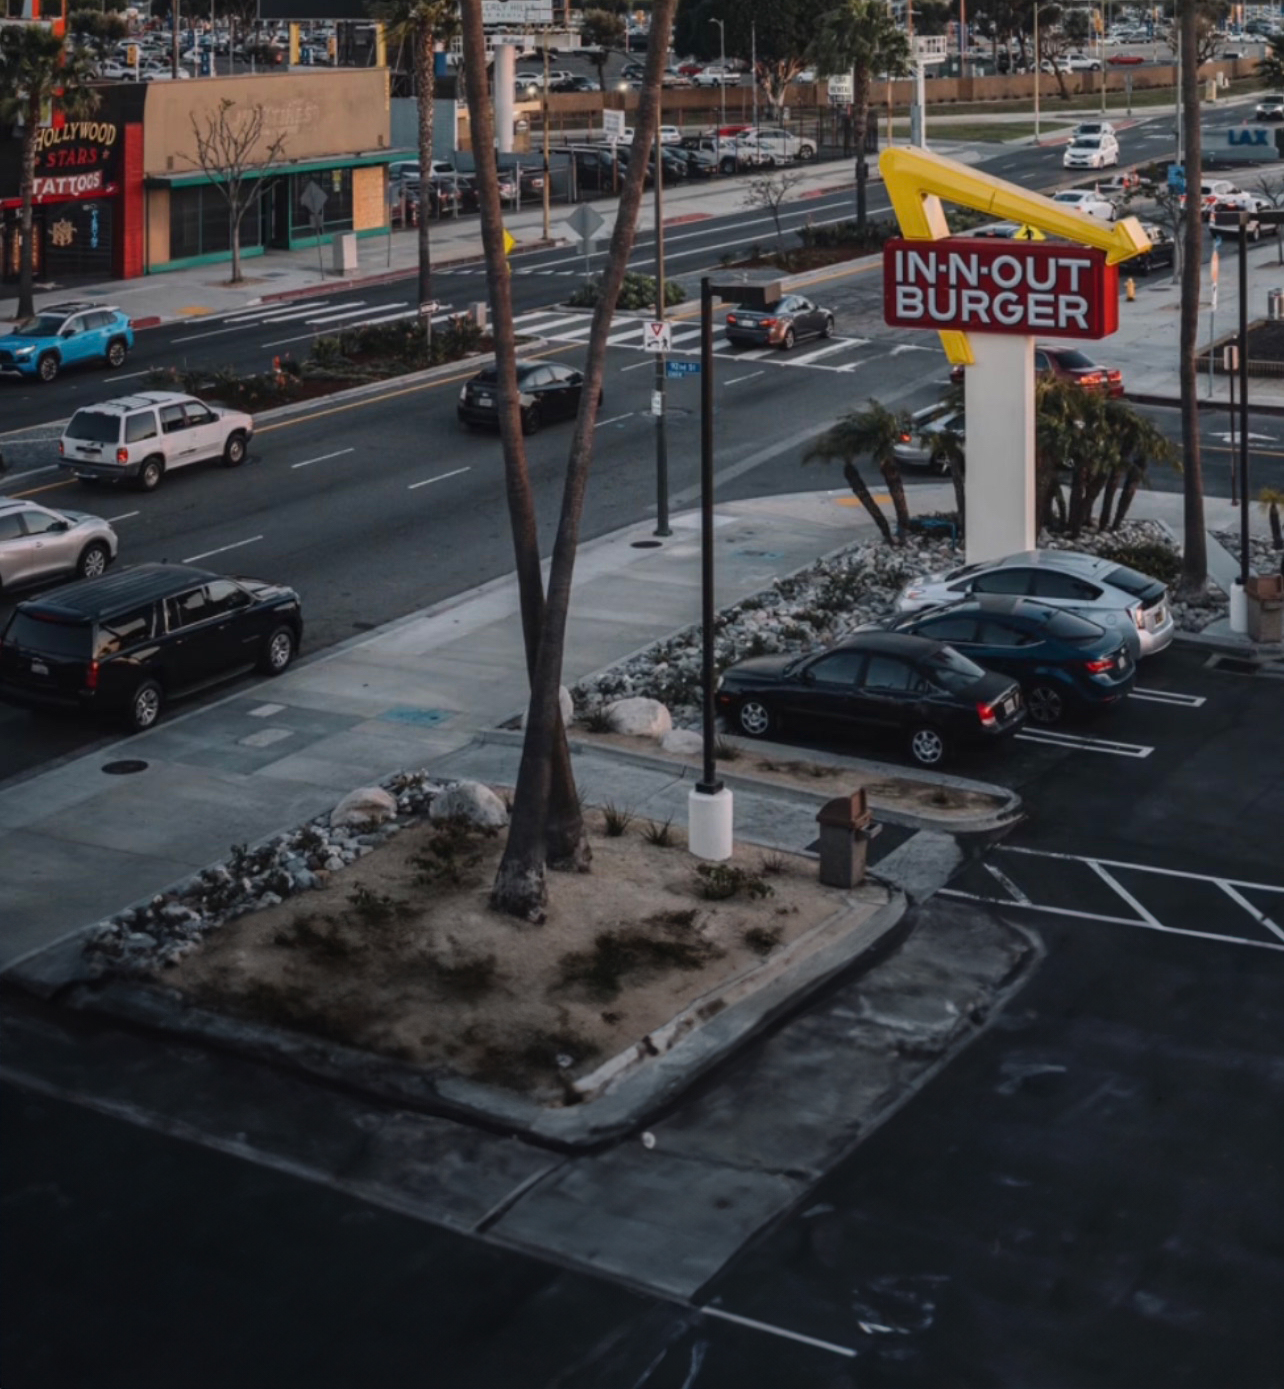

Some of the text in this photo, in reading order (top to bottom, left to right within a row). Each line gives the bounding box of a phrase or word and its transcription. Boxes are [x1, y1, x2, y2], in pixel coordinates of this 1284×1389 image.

[34, 122, 117, 152] HOLLYWOOD
[1228, 129, 1268, 146] LAX
[47, 147, 98, 167] STARS
[31, 172, 101, 199] TATTOOS
[895, 250, 1091, 292] IN-N-OUT
[896, 285, 1089, 329] BURGER
